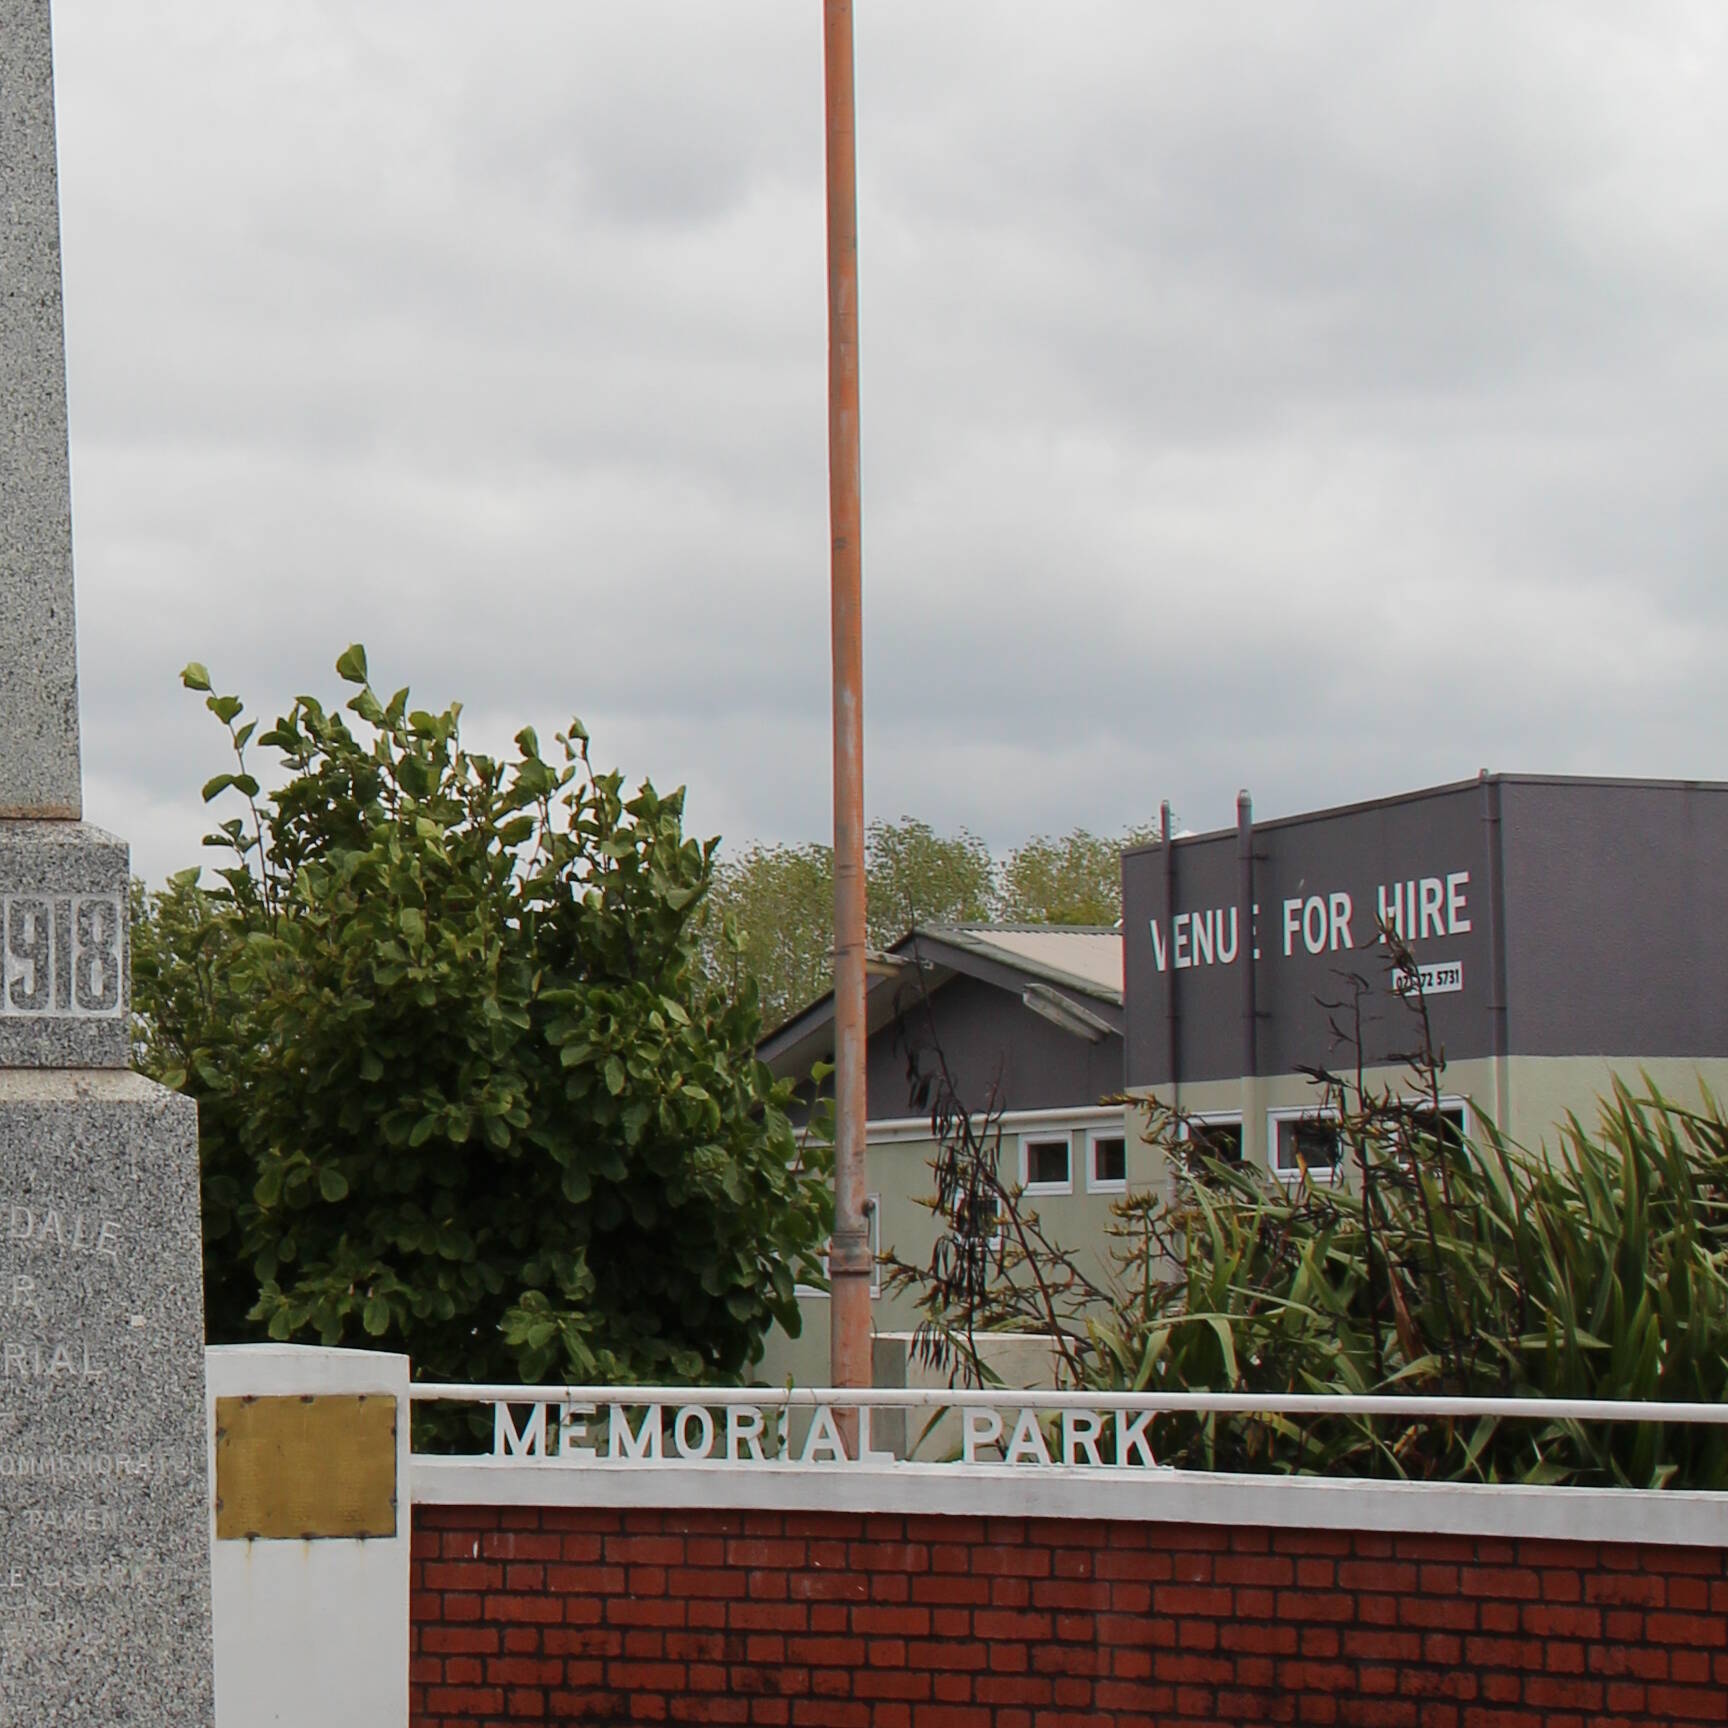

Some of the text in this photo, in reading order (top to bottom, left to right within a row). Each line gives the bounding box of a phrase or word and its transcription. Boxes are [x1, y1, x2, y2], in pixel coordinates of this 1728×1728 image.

[1284, 892, 1354, 957] FOR
[1377, 871, 1472, 944] HIRE
[1436, 968, 1460, 986] 5731
[493, 1401, 1158, 1467] MEMORIAL PARK
